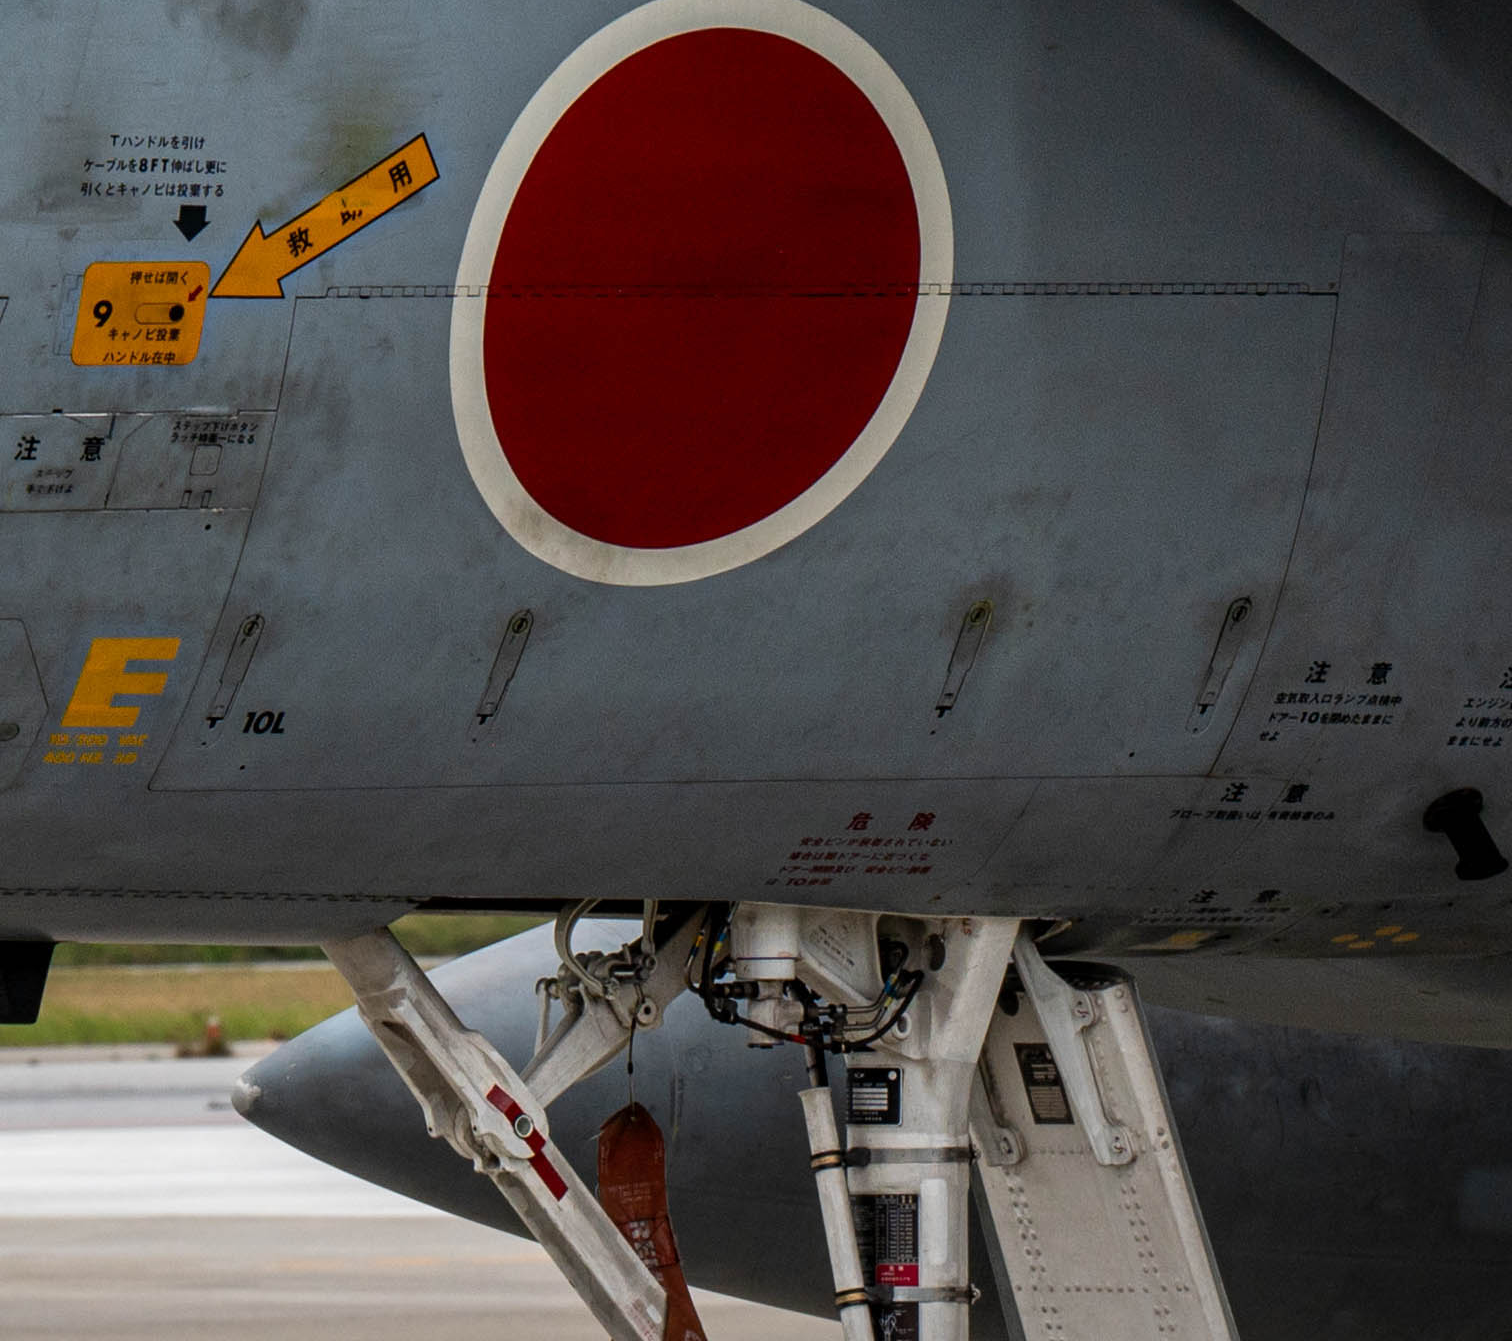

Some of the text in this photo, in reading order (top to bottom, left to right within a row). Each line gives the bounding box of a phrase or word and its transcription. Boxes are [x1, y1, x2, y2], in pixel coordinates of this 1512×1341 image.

[93, 300, 113, 328] 9
[14, 435, 105, 461] 注意
[61, 638, 181, 727] E
[1305, 661, 1393, 685] 注意
[243, 712, 286, 734] 10L
[1220, 783, 1310, 803] 注意
[846, 812, 936, 830] 危険
